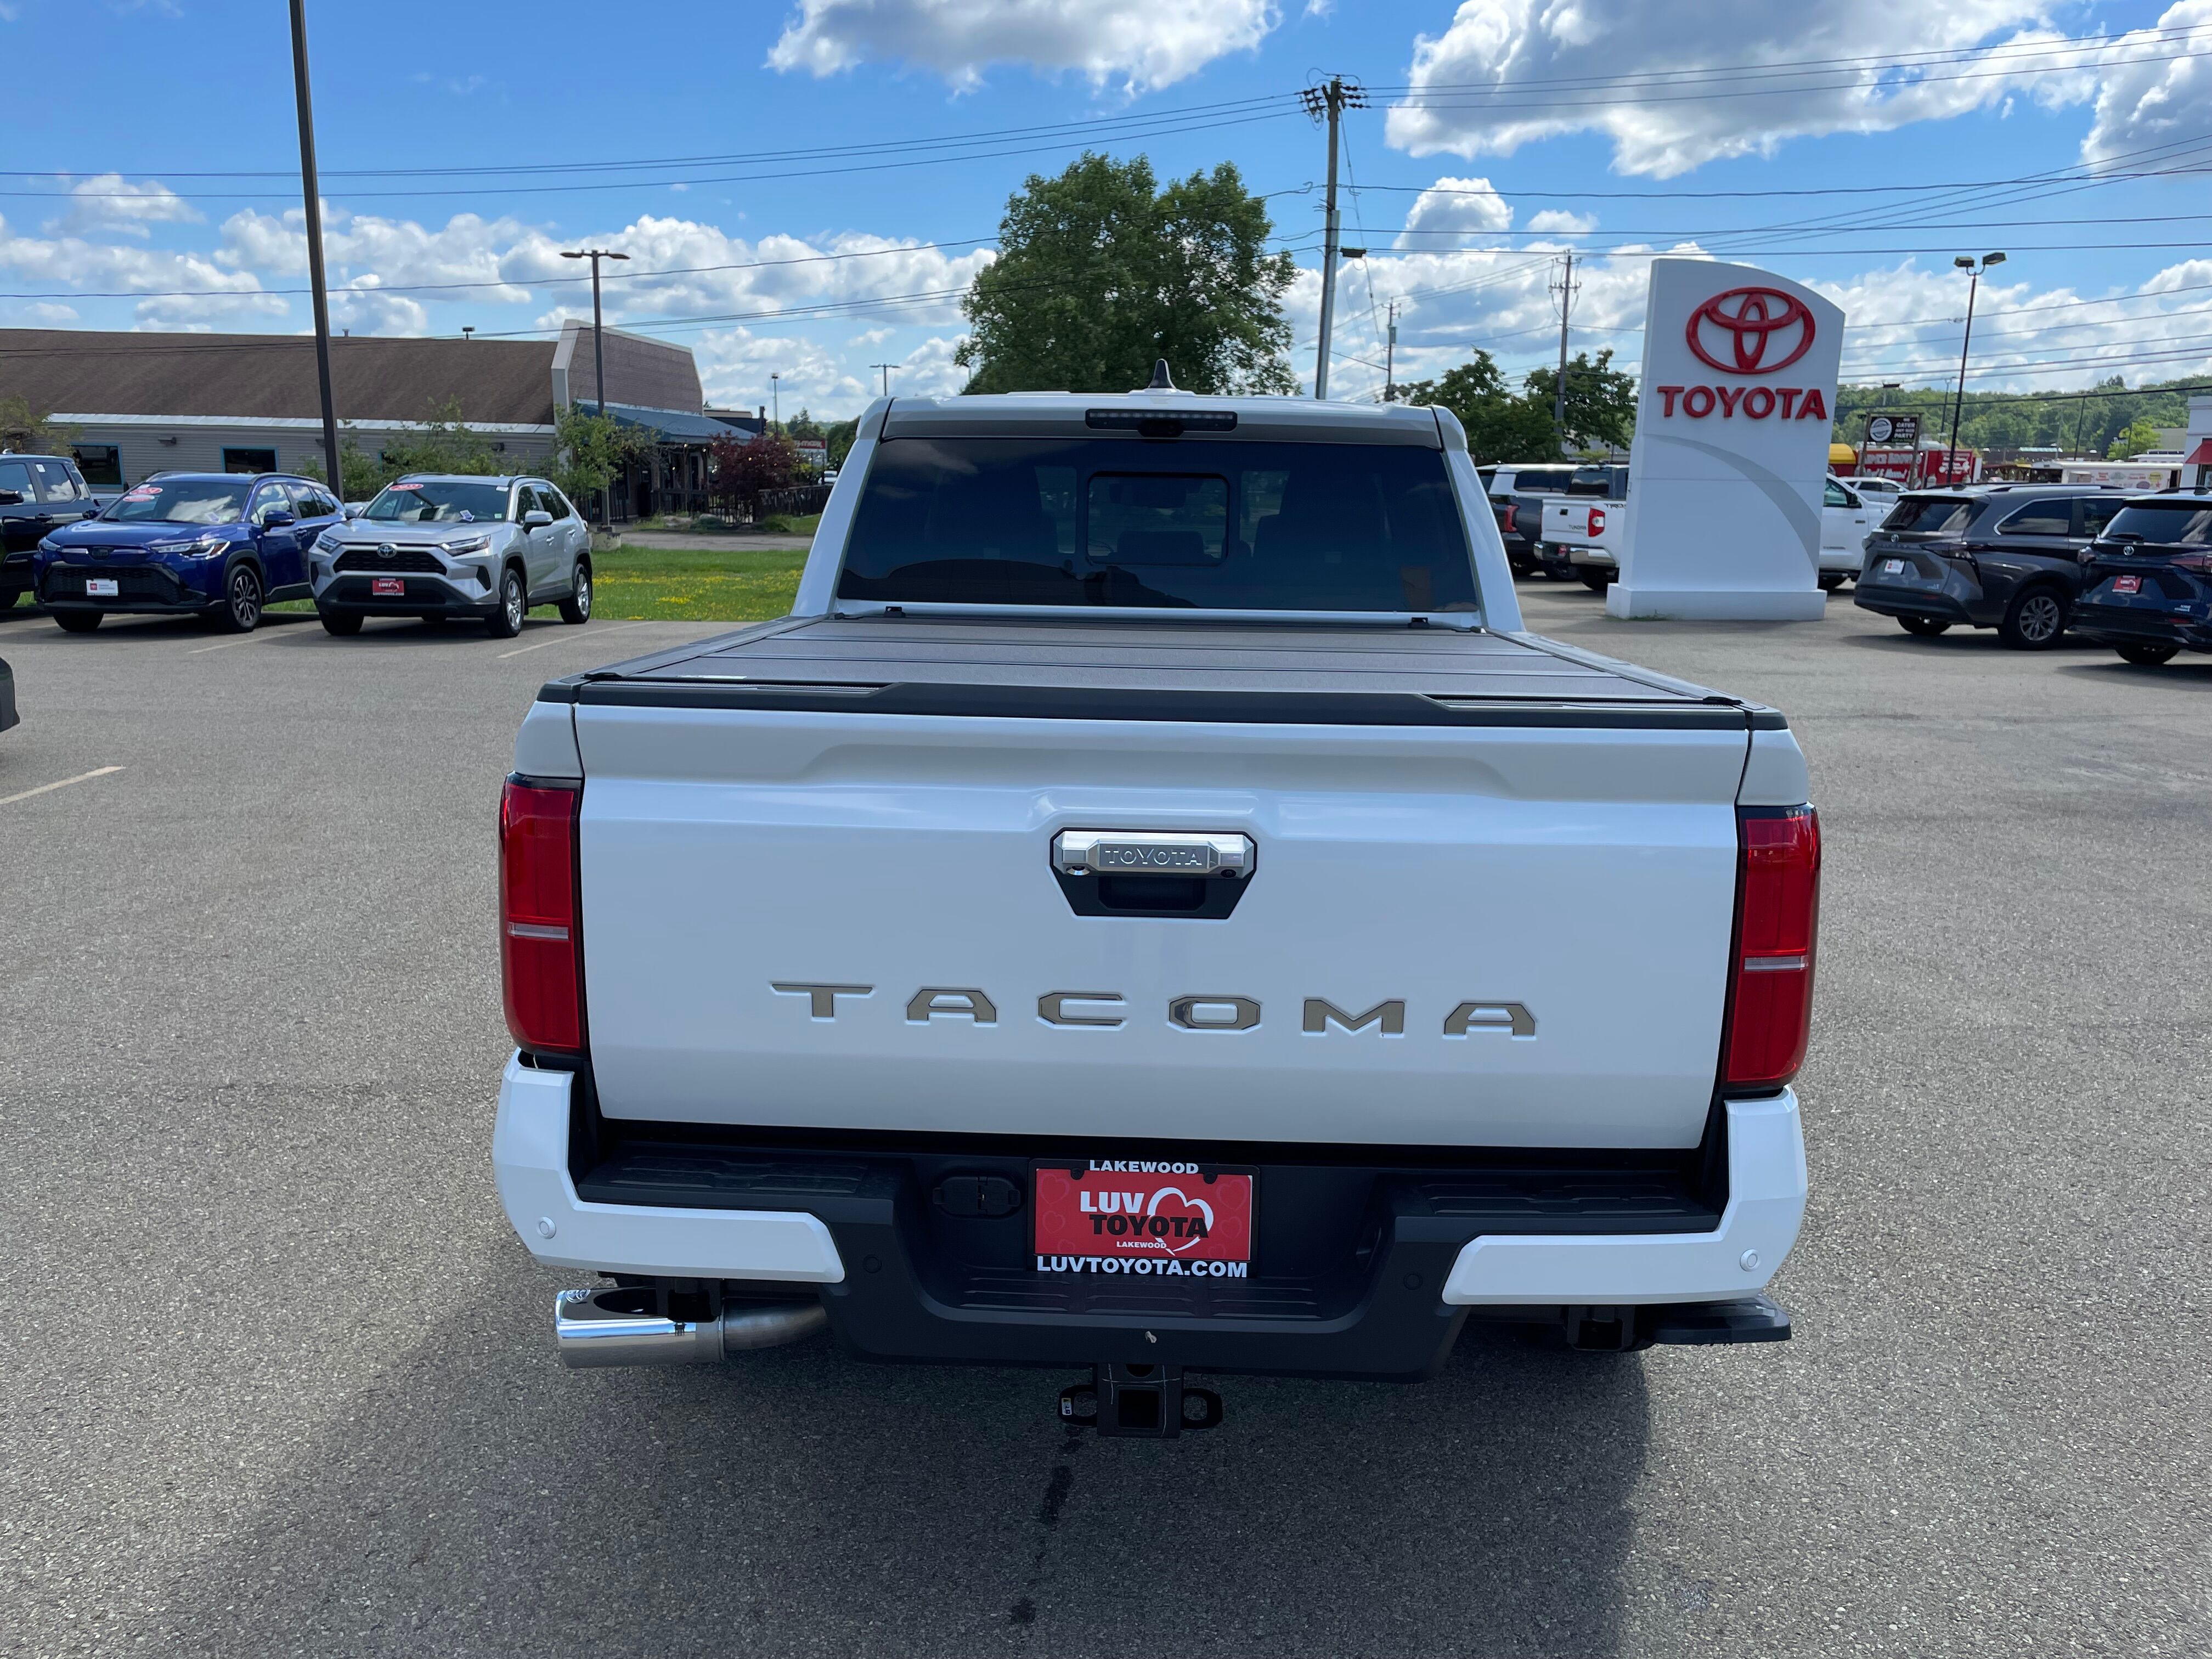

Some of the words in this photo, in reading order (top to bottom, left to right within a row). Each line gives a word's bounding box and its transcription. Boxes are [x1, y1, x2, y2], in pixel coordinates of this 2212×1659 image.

[1657, 385, 1827, 420] TOYOTA
[1104, 847, 1203, 866] TOYOTA
[770, 984, 1536, 1041] TACOMA
[1090, 1160, 1199, 1174] LAKEWOOD
[1080, 1191, 1144, 1213] LUV
[1089, 1214, 1209, 1238] TOYOTA
[1116, 1241, 1167, 1249] LAKEWOOD
[1037, 1255, 1247, 1278] LUVTOYOTA.COM
